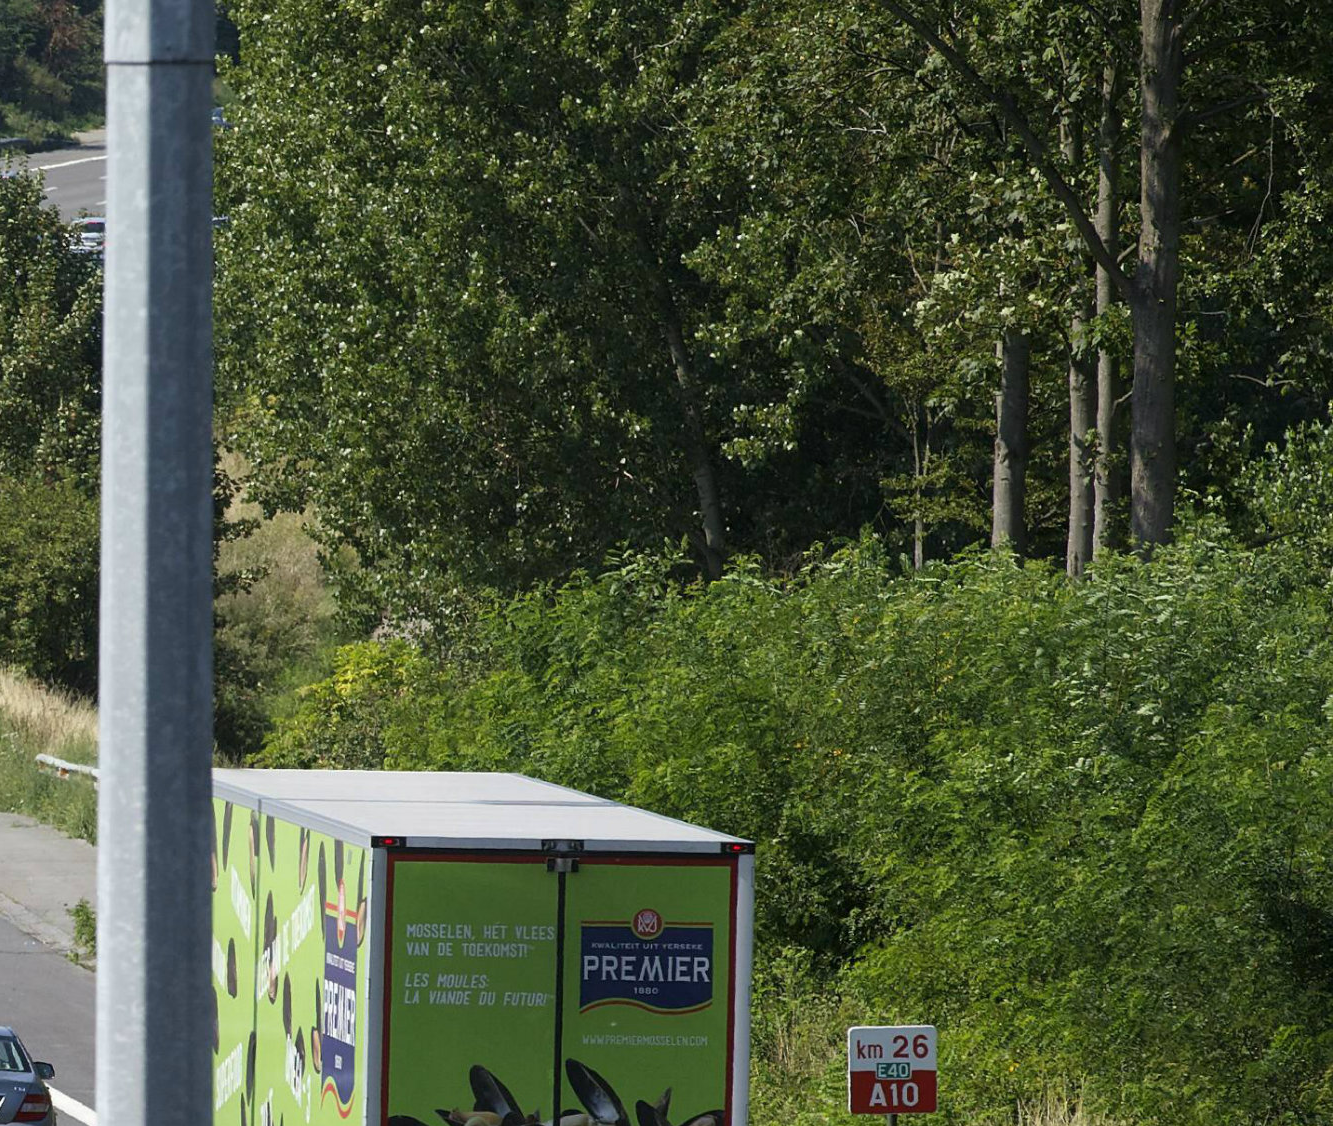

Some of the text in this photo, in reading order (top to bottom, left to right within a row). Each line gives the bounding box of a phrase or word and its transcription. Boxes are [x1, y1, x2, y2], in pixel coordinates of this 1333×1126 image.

[406, 924, 475, 940] MOSSELEN,
[515, 926, 555, 940] VLEES
[406, 942, 429, 956] VAN
[437, 942, 453, 956] DE
[591, 942, 640, 950] KWALITEIT
[643, 942, 659, 950] UIT
[583, 955, 711, 983] PREMIER
[404, 973, 430, 988] LES
[404, 990, 420, 1004] LA
[429, 991, 472, 1005] VIANDE
[479, 992, 496, 1006] DU
[633, 987, 659, 995] 1880
[856, 1034, 929, 1059] km 26
[878, 1064, 909, 1078] E40
[869, 1082, 919, 1107] A10
